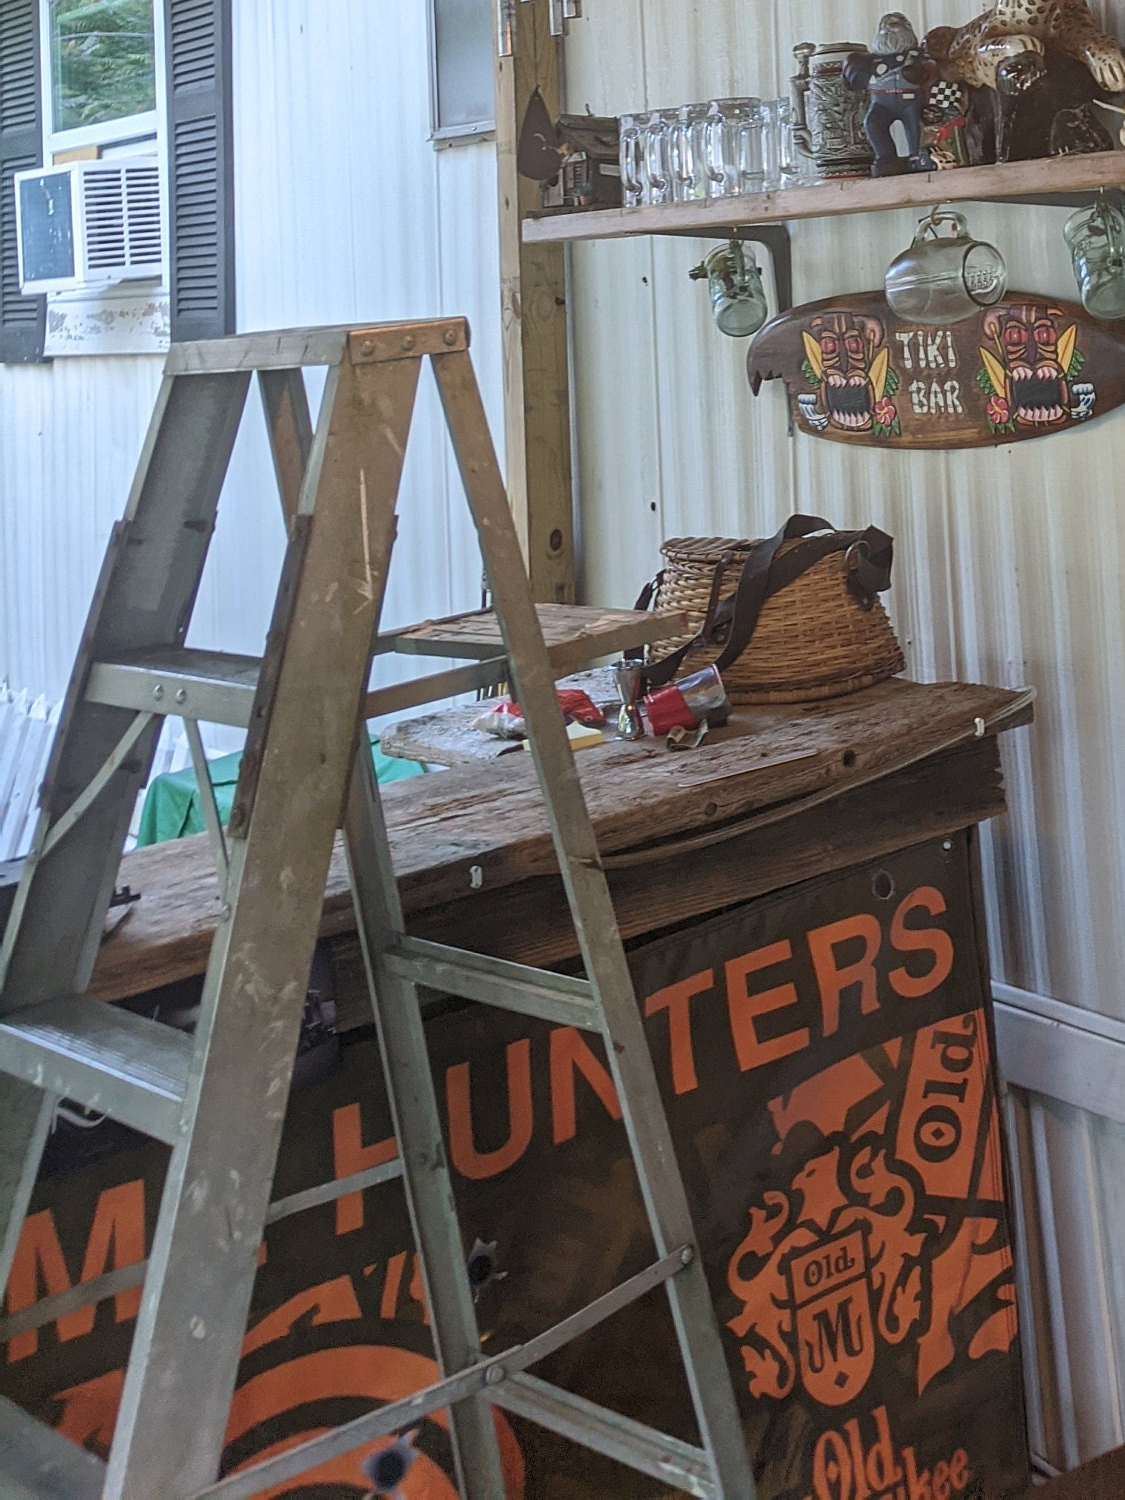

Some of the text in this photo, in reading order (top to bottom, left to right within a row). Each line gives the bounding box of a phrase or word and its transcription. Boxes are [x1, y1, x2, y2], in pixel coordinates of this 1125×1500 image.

[895, 330, 958, 369] TIKI
[908, 378, 964, 415] BAR
[913, 1013, 977, 1164] Old
[804, 1245, 856, 1288] Old
[813, 1404, 902, 1500] Old
